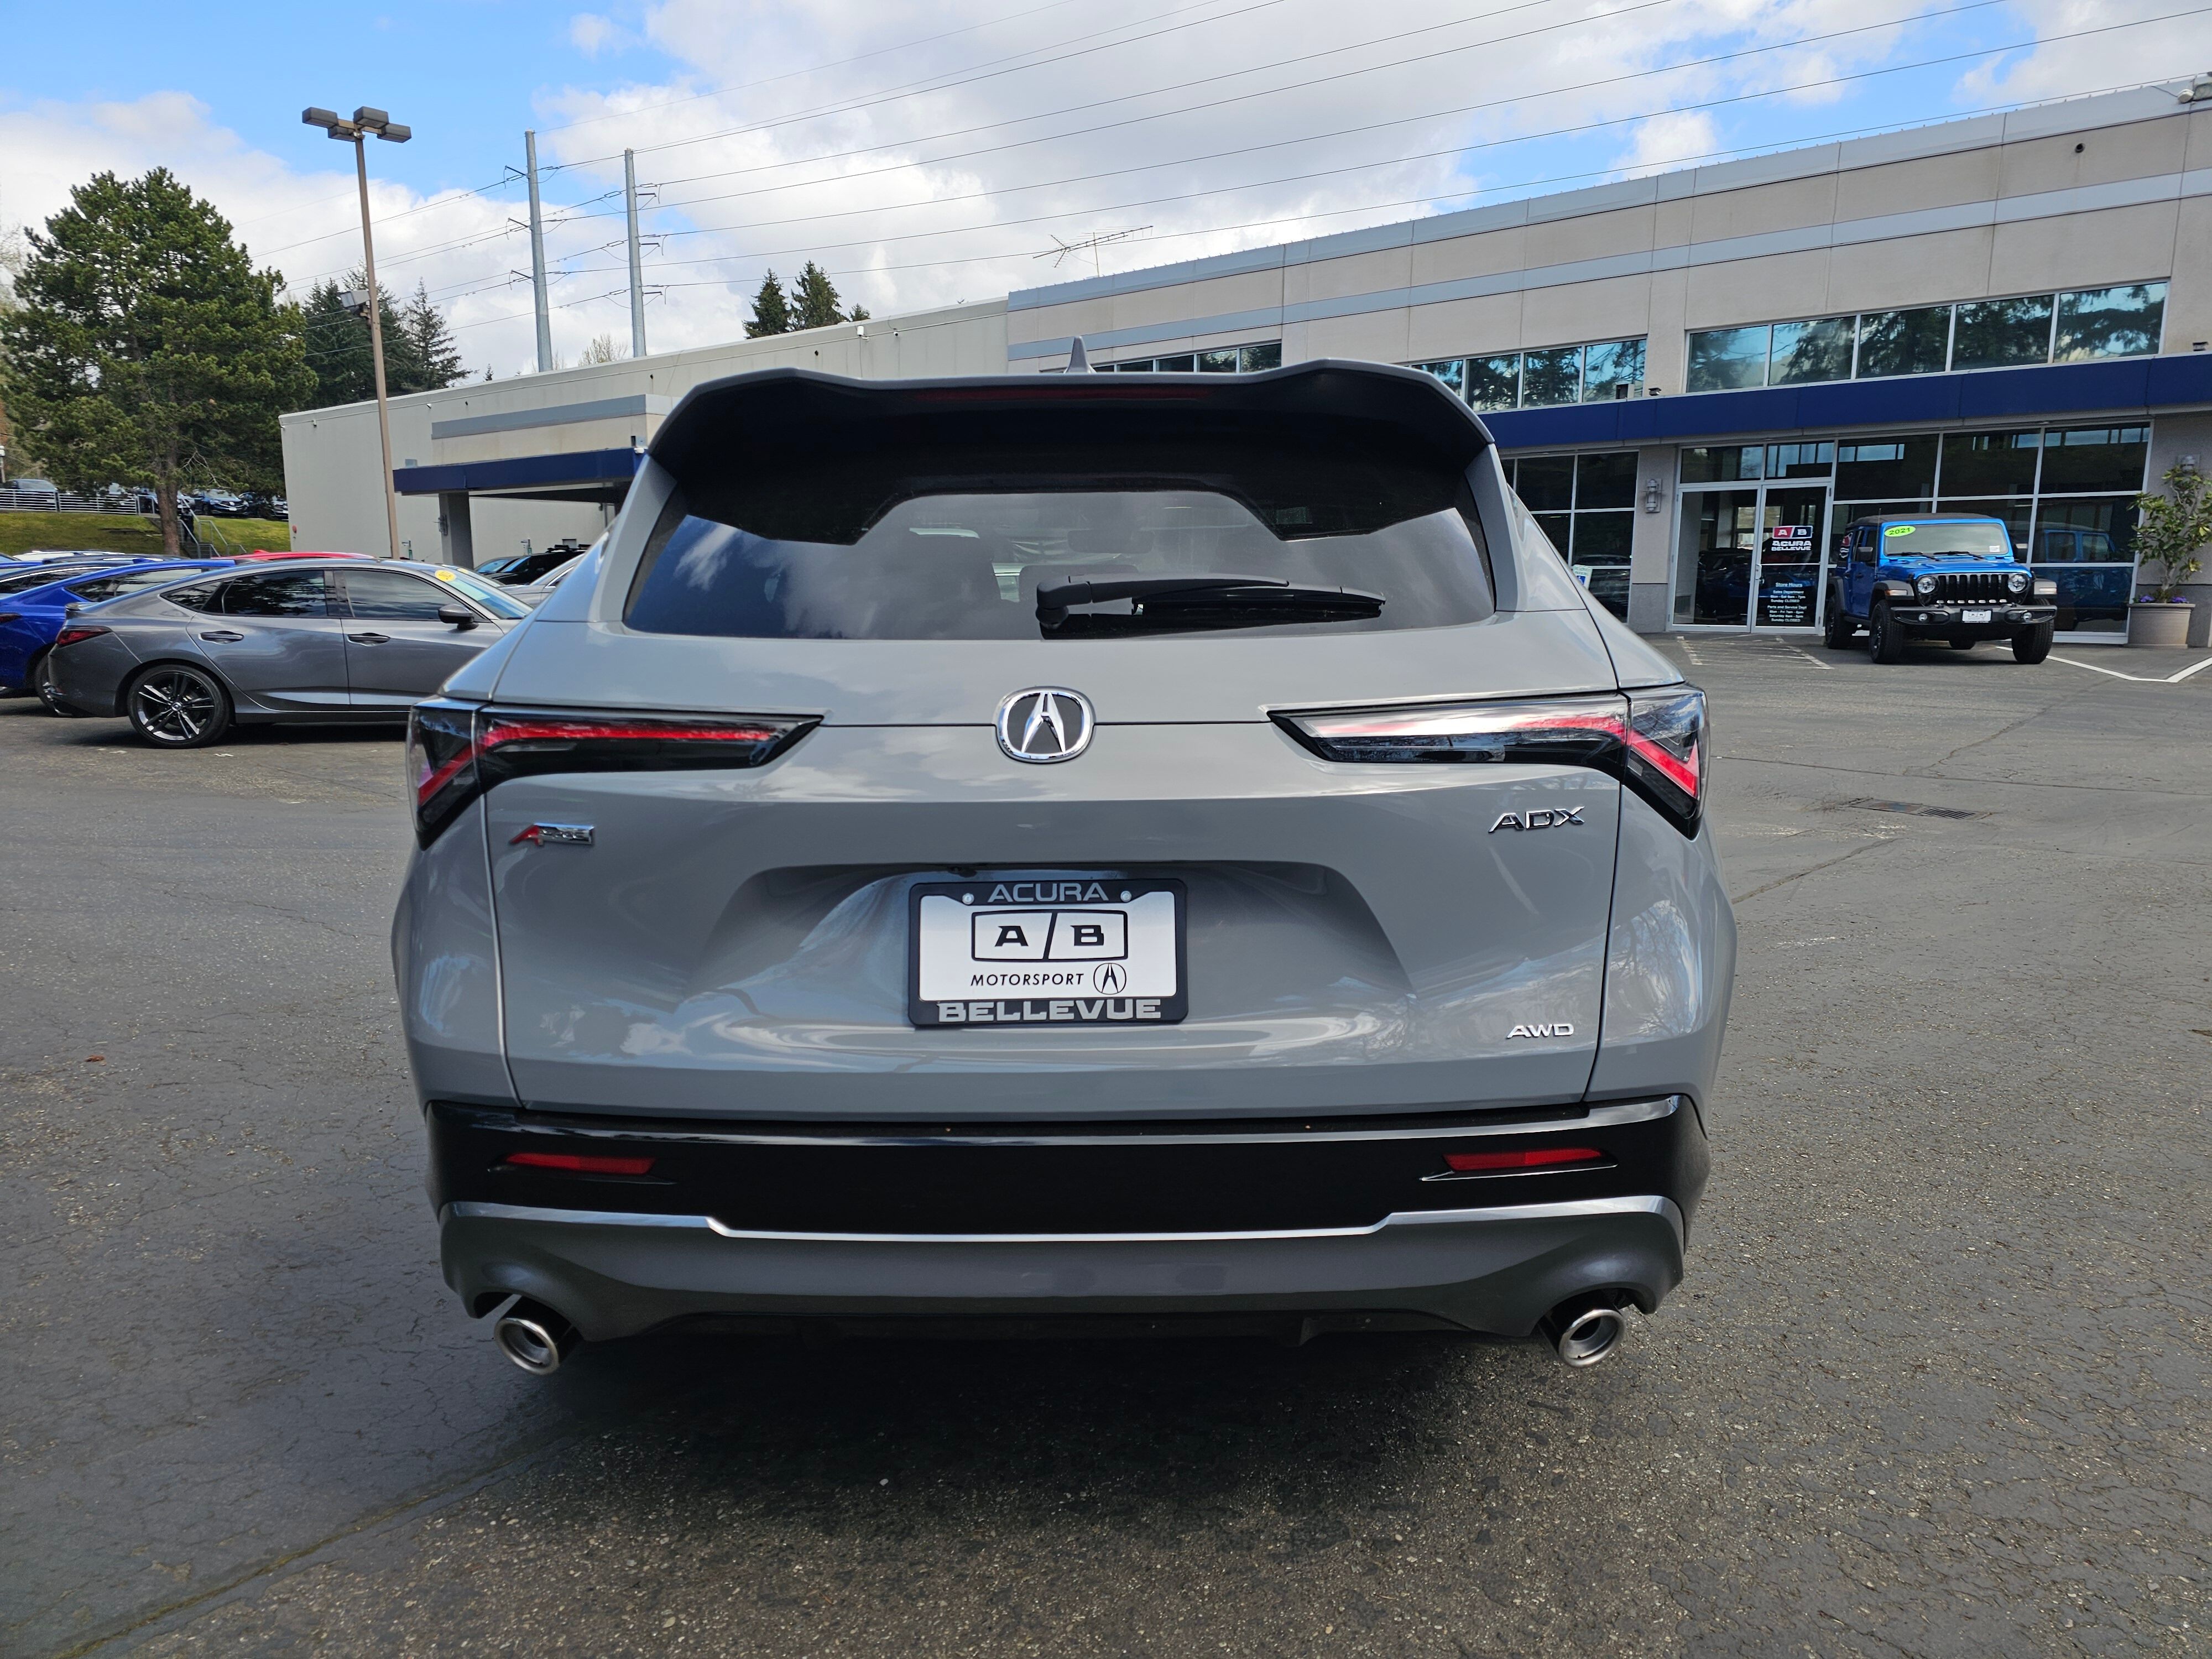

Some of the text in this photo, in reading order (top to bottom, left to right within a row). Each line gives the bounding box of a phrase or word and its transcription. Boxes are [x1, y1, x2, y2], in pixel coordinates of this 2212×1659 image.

[1488, 806, 1585, 833] ADX
[987, 883, 1109, 903] ACURA
[995, 925, 1104, 947] A B
[971, 973, 1084, 987] MOTORSPORT
[937, 999, 1161, 1022] BELLEVUE
[1505, 1023, 1574, 1039] AWD
